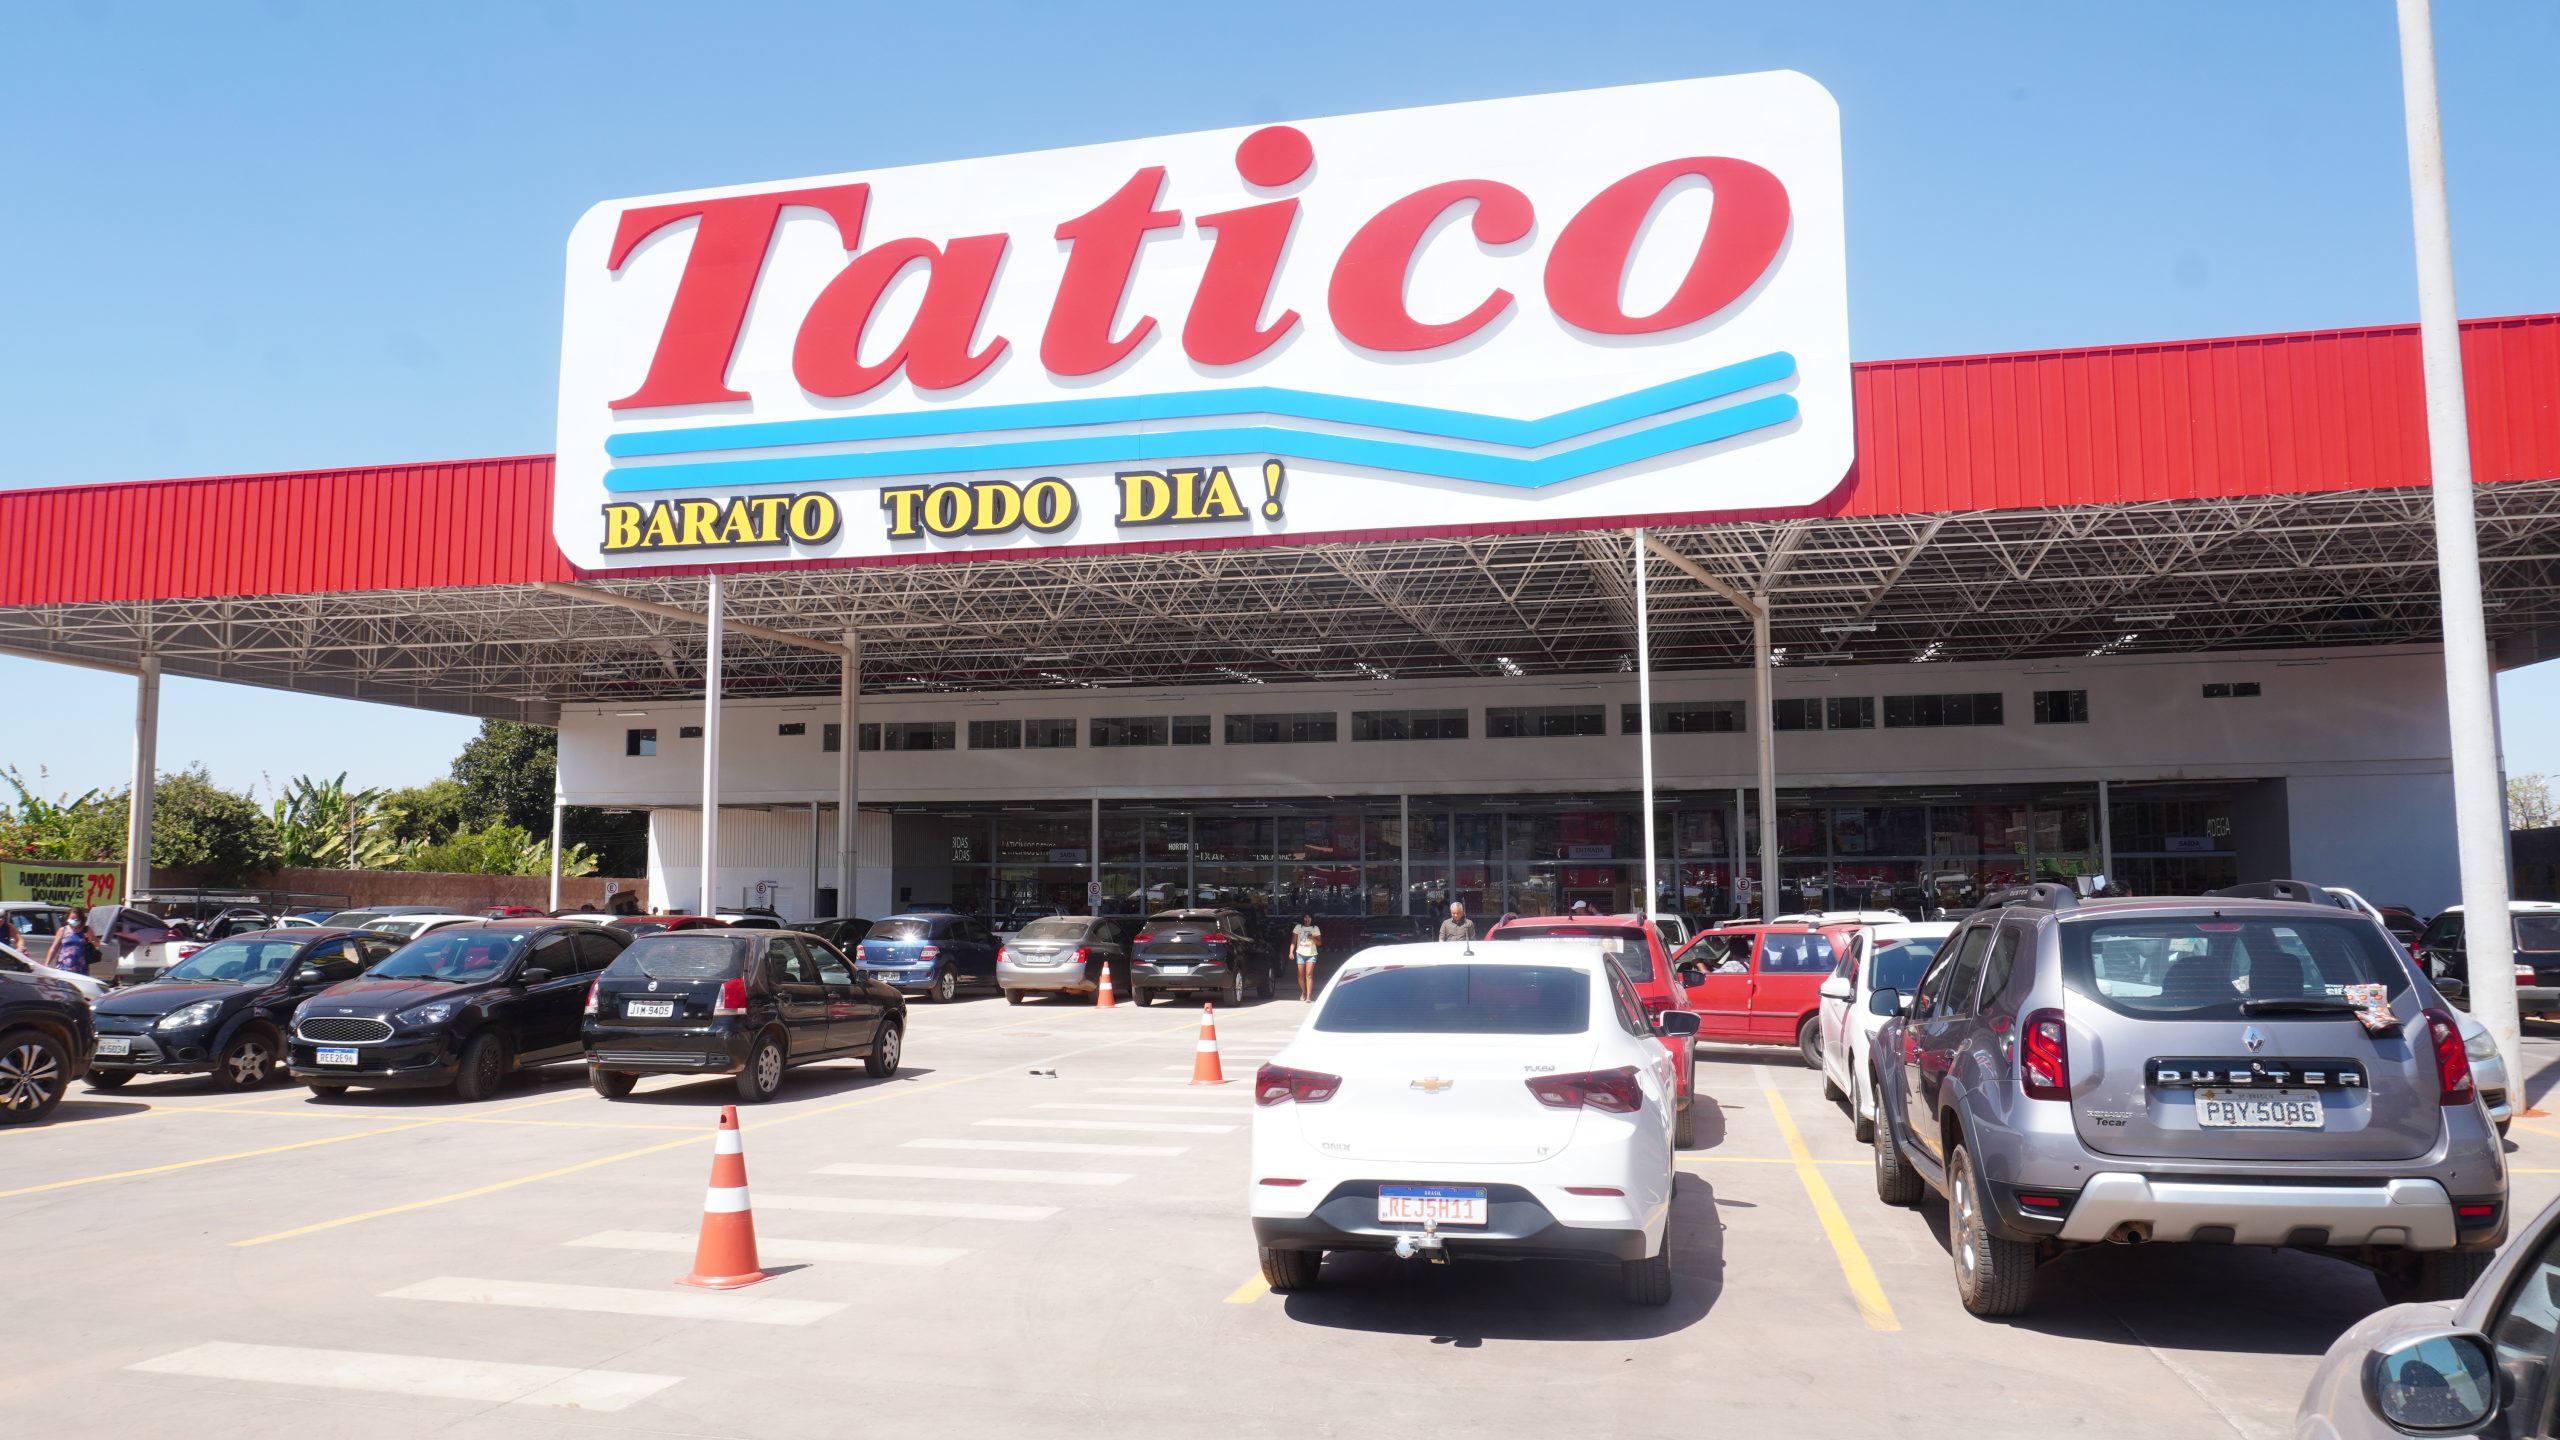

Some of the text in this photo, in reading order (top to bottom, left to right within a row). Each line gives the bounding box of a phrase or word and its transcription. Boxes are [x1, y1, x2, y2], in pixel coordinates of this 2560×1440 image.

[608, 126, 1790, 410] Tatico
[602, 458, 1287, 553] BARATO TODO DIA!
[2206, 817, 2231, 837] ADEGA
[19, 872, 84, 888] AMACIANTE
[2009, 889, 2029, 897] DUSTER
[320, 1053, 354, 1063] REE2E96
[2157, 1070, 2361, 1085] DUSTER
[2095, 1117, 2128, 1127] Tecar
[1321, 1142, 1351, 1152] ONIX
[1537, 1147, 1550, 1155] LT
[1389, 1197, 1474, 1219] REJ5H11
